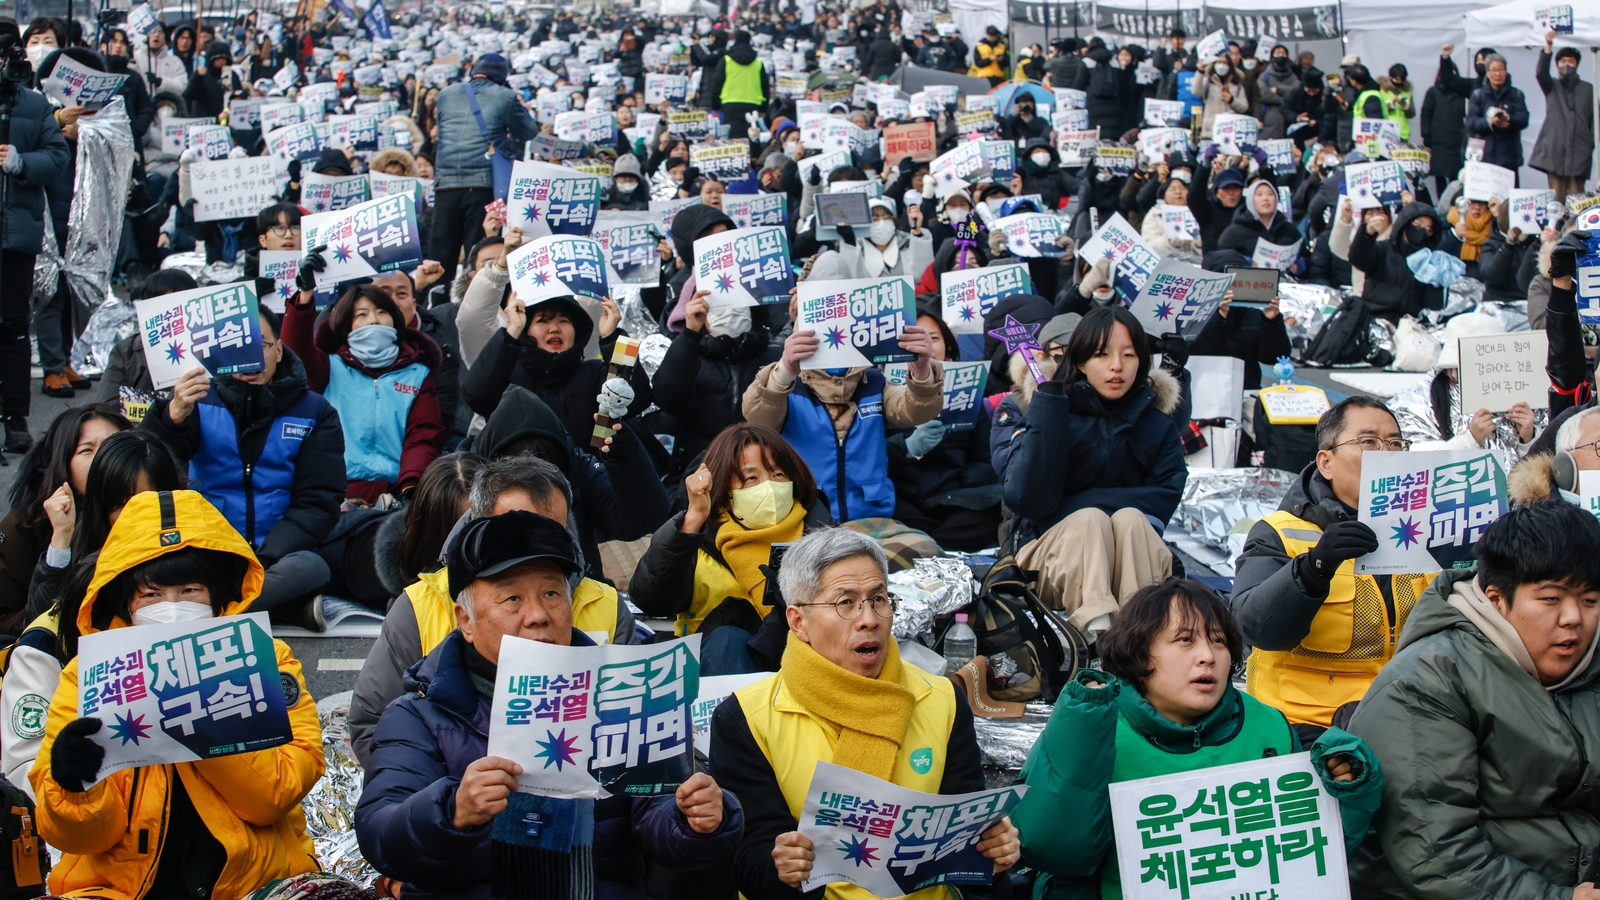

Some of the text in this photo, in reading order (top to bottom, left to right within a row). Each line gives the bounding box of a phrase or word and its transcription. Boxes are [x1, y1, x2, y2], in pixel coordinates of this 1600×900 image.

[589, 127, 613, 142] 하라
[205, 143, 231, 159] 하라
[956, 155, 983, 178] 하라
[333, 176, 365, 198] 체포!
[513, 188, 548, 201] 윤석열
[515, 178, 550, 188] 내란수괴
[550, 178, 597, 202] 체포!
[1372, 178, 1402, 197] 구속!
[355, 195, 407, 233] 체포!
[547, 203, 593, 227] 구속!
[750, 195, 782, 213] 체포!
[321, 216, 352, 239] 내란수괴
[750, 210, 783, 225] 구속!
[1027, 216, 1057, 232] 체포!
[358, 220, 410, 258] 구속!
[611, 223, 654, 248] 체포!
[736, 228, 783, 262] 체포!
[957, 231, 977, 240] OUT
[1101, 231, 1130, 254] 윤석열
[1107, 225, 1136, 247] 내란수괴
[514, 246, 549, 271] 내란수괴
[552, 240, 599, 262] 체포!
[612, 246, 654, 270] 구속!
[699, 242, 733, 265] 내란수괴
[265, 260, 297, 272] 내란수괴
[515, 254, 550, 281] 윤석열
[557, 262, 602, 284] 구속!
[700, 253, 734, 279] 윤석열
[741, 256, 788, 289] 구속!
[946, 278, 975, 295] 내란수괴
[977, 266, 1023, 297] 체포!
[1148, 283, 1188, 301] 윤석열
[1155, 273, 1195, 288] 내란수괴
[1189, 275, 1232, 302] 체포!
[187, 287, 248, 329] 체포!
[803, 292, 848, 313] 내란동조
[851, 279, 904, 318] 해체
[947, 288, 976, 308] 윤석열
[145, 305, 183, 331] 내란수괴
[804, 305, 848, 325] 국민의힘
[1177, 301, 1218, 329] 구속!
[147, 318, 185, 347] 윤석열
[192, 317, 253, 359] 구속!
[852, 312, 906, 348] 하라
[1475, 340, 1531, 356] 연대의 힘이
[1474, 360, 1533, 376] 강하다는 것을
[394, 381, 420, 397] 진보당
[1481, 380, 1529, 396] 보여주마
[129, 406, 148, 418] 내란
[1371, 469, 1429, 495] 내란수괴
[1433, 456, 1497, 506] 즉각
[1369, 487, 1428, 518] 윤석열
[1429, 499, 1499, 549] 파면
[83, 648, 145, 688] 내란수괴
[151, 621, 258, 692] 체포!
[508, 669, 591, 697] 내란수괴
[596, 646, 687, 717] 즉각
[83, 675, 149, 717] 윤석열
[162, 672, 270, 737] 구속!
[505, 692, 589, 725] 윤석열
[692, 696, 729, 718] 내란
[590, 707, 687, 770] 파면
[913, 757, 931, 767] 정의당
[820, 791, 901, 820] 내란수괴
[900, 791, 1009, 841] 체포!
[1136, 771, 1320, 850] 윤석열을
[814, 808, 895, 840] 윤석열
[890, 820, 987, 876] 구속!
[1140, 826, 1328, 900] 체포하라
